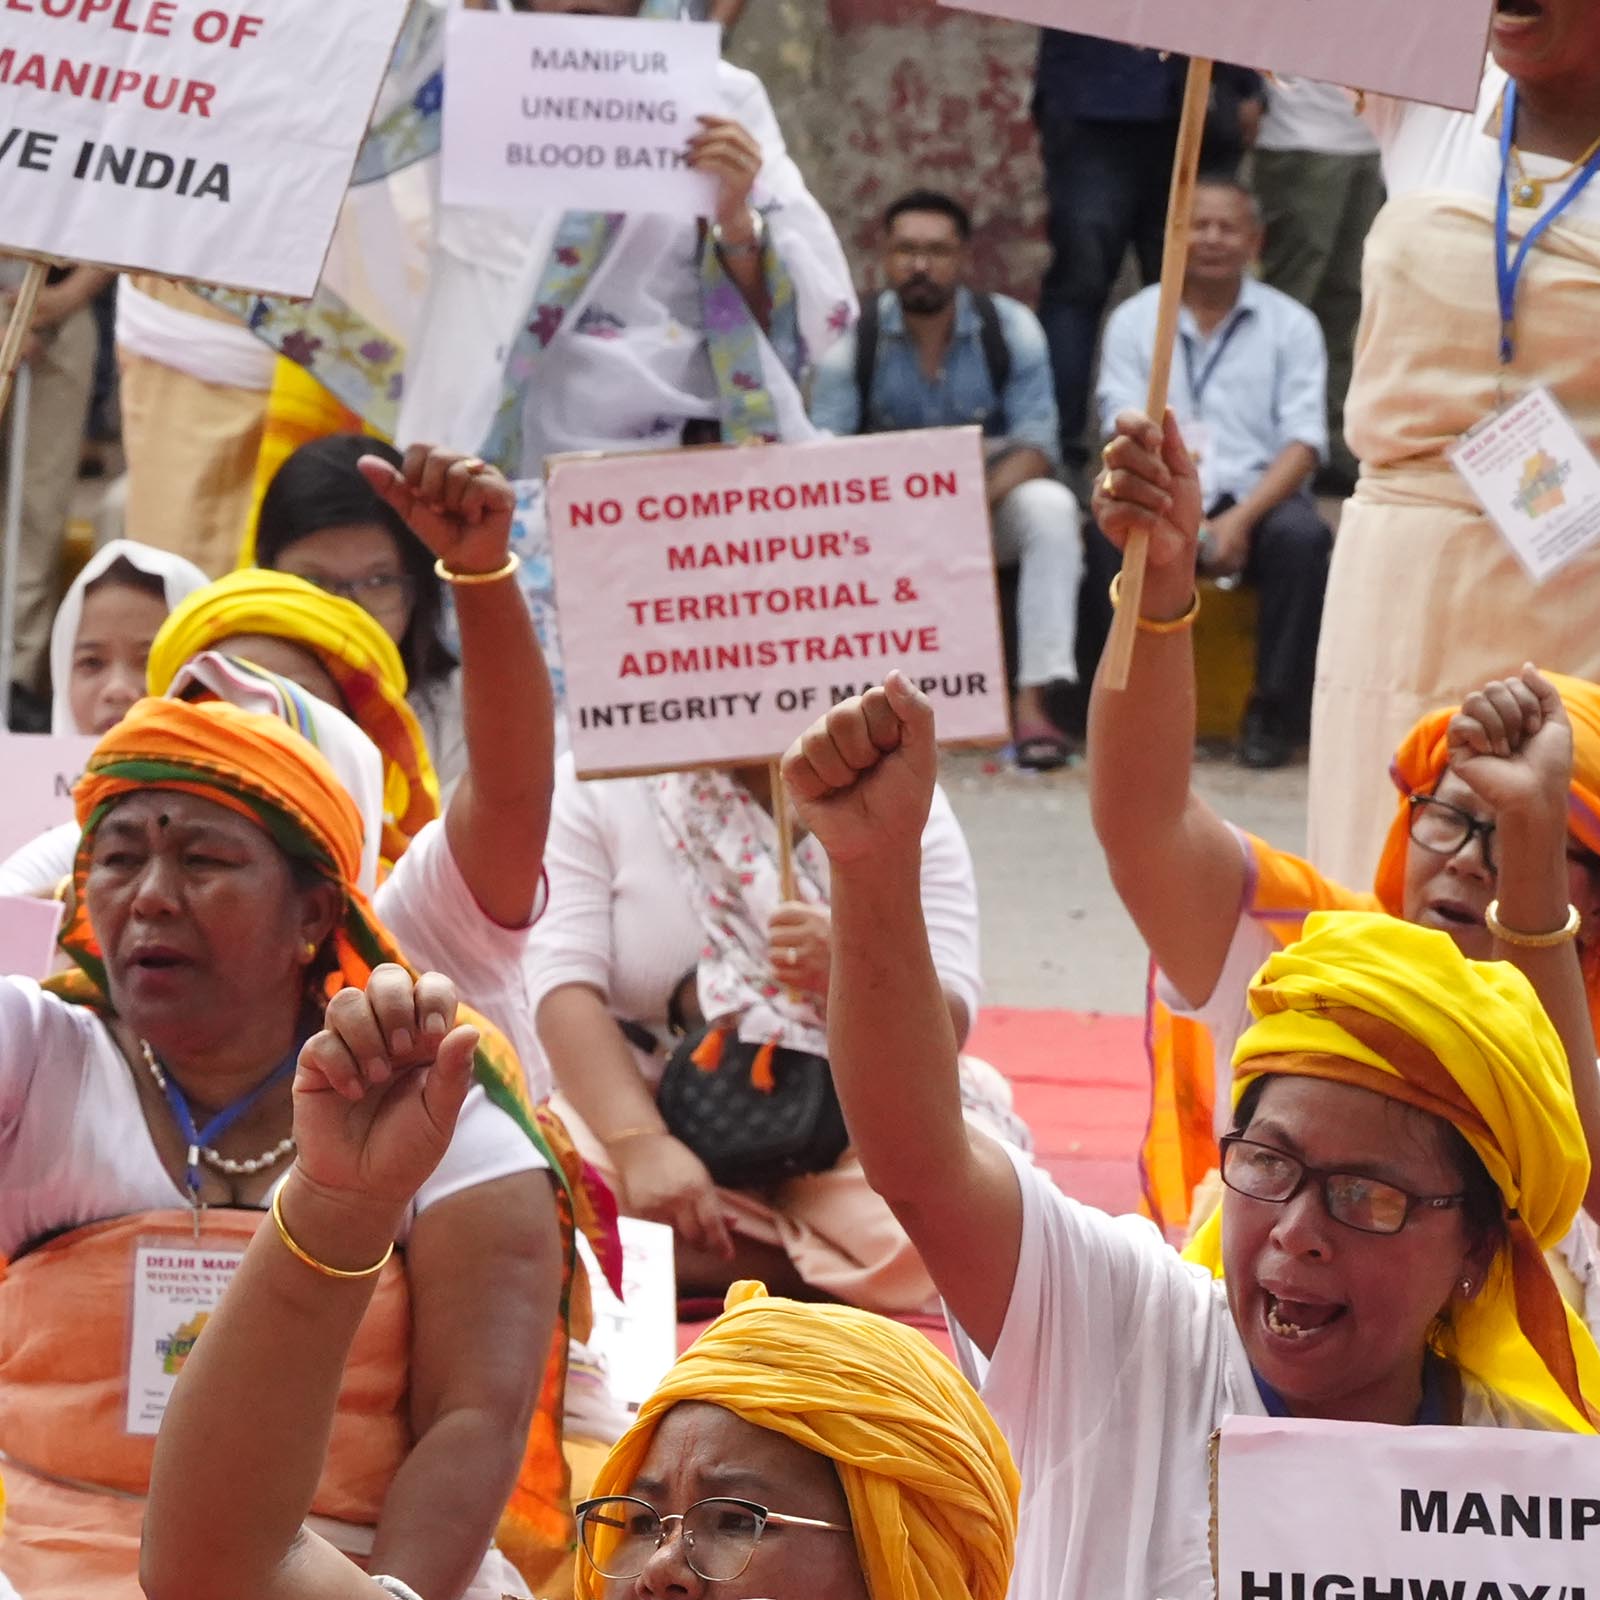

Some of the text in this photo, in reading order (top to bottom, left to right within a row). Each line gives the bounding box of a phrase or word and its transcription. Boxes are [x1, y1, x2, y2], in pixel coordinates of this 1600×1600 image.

[192, 10, 263, 49] OF
[531, 48, 668, 73] MANIPUR
[521, 97, 678, 124] UNENDING
[73, 141, 231, 202] INDIA
[506, 143, 605, 168] BLOOD
[570, 471, 957, 528] NO COMPROMISE ON
[667, 531, 870, 571] MANIPUR's
[628, 577, 919, 626] TERRITORIAL &
[618, 627, 939, 678] ADMINISTRATIVE
[580, 673, 988, 730] INTEGRITY OF MPUR
